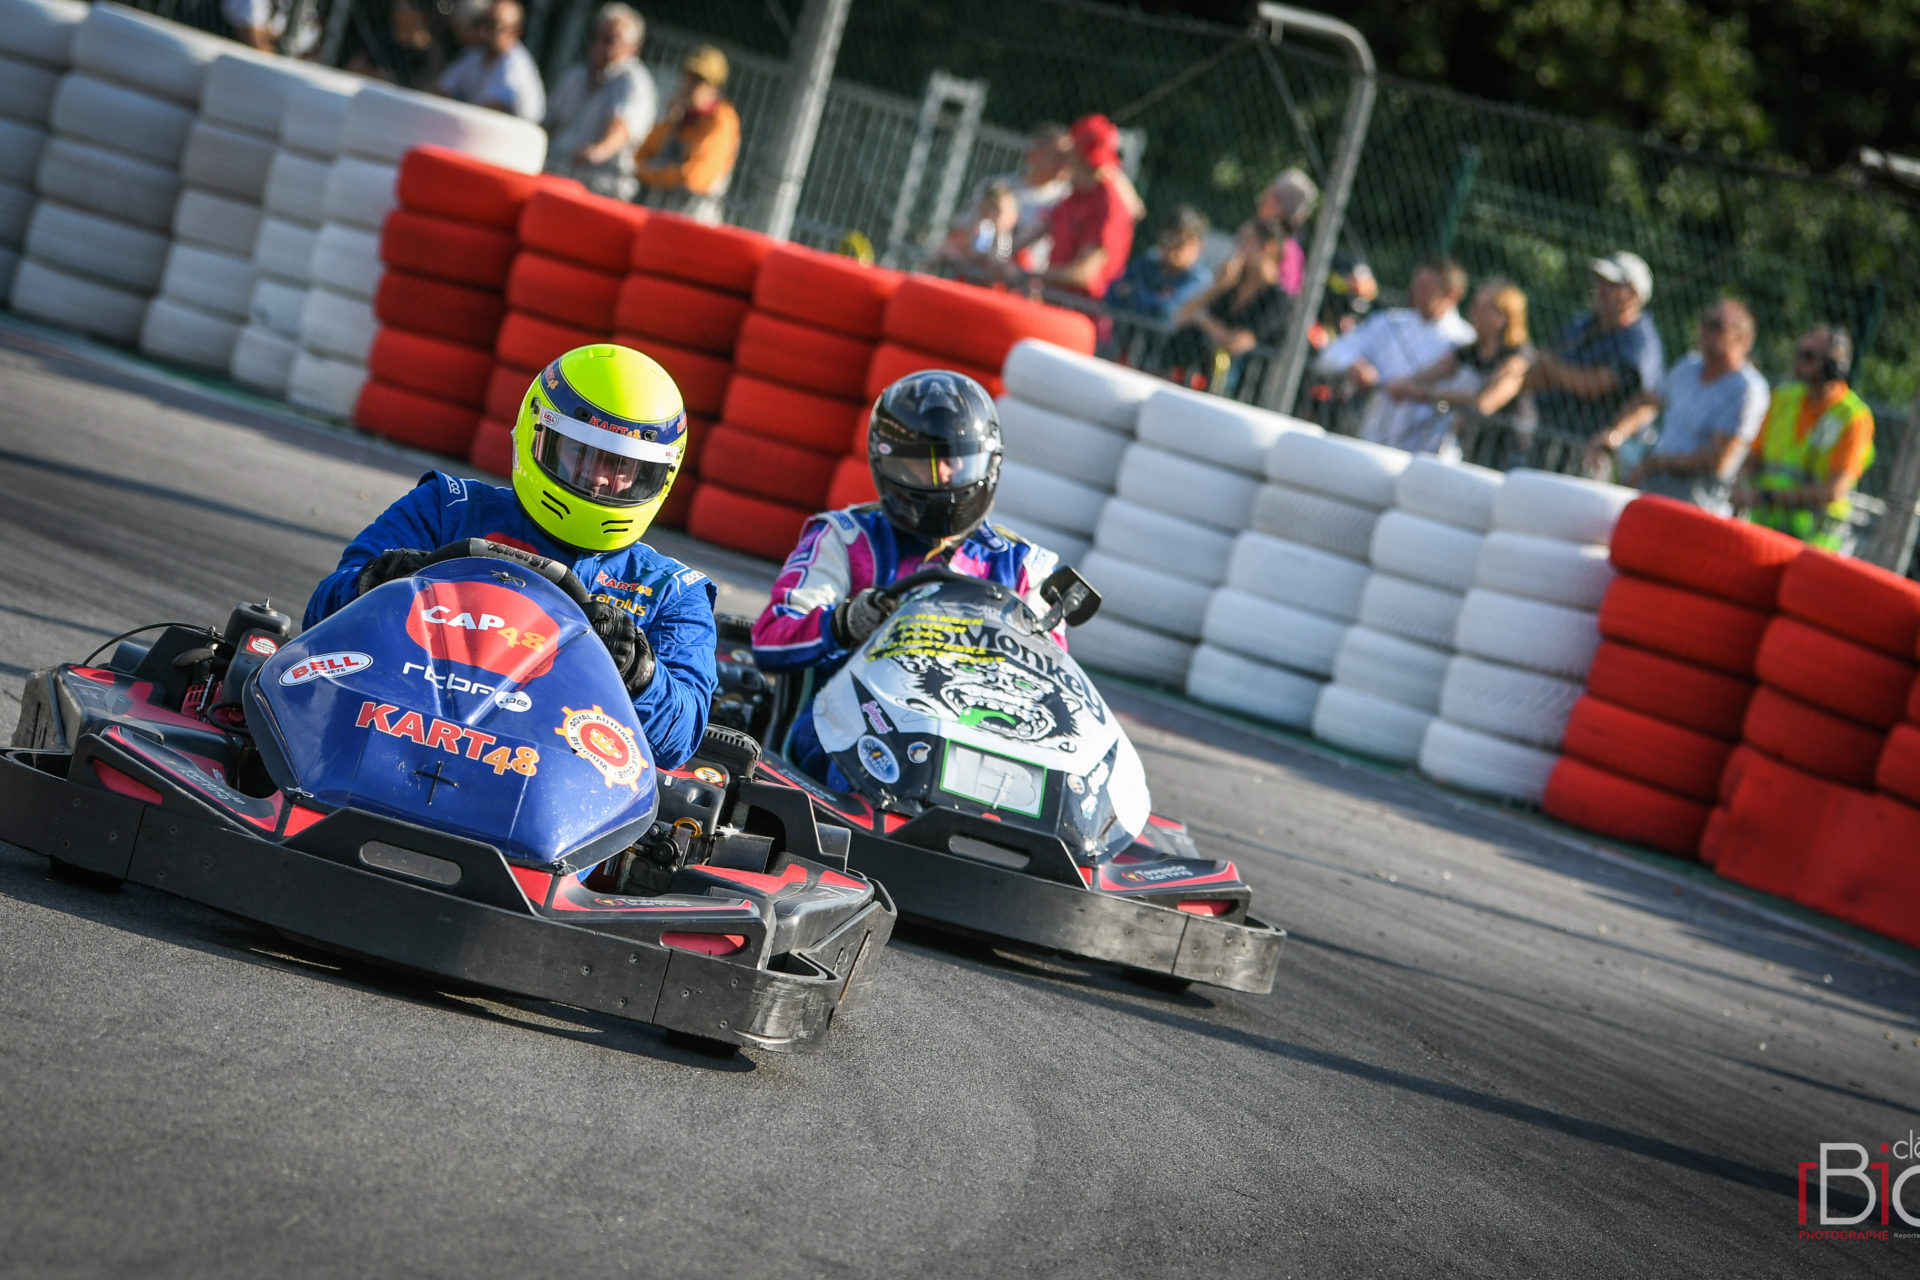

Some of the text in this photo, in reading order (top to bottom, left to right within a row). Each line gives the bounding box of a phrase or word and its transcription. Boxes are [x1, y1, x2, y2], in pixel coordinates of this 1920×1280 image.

[589, 416, 641, 439] KART48
[596, 570, 653, 597] KART48
[421, 605, 547, 652] CAP48
[291, 656, 360, 679] BELL
[569, 713, 593, 728] ROYAL
[355, 701, 540, 777] KART48
[571, 735, 608, 771] BELGIUM
